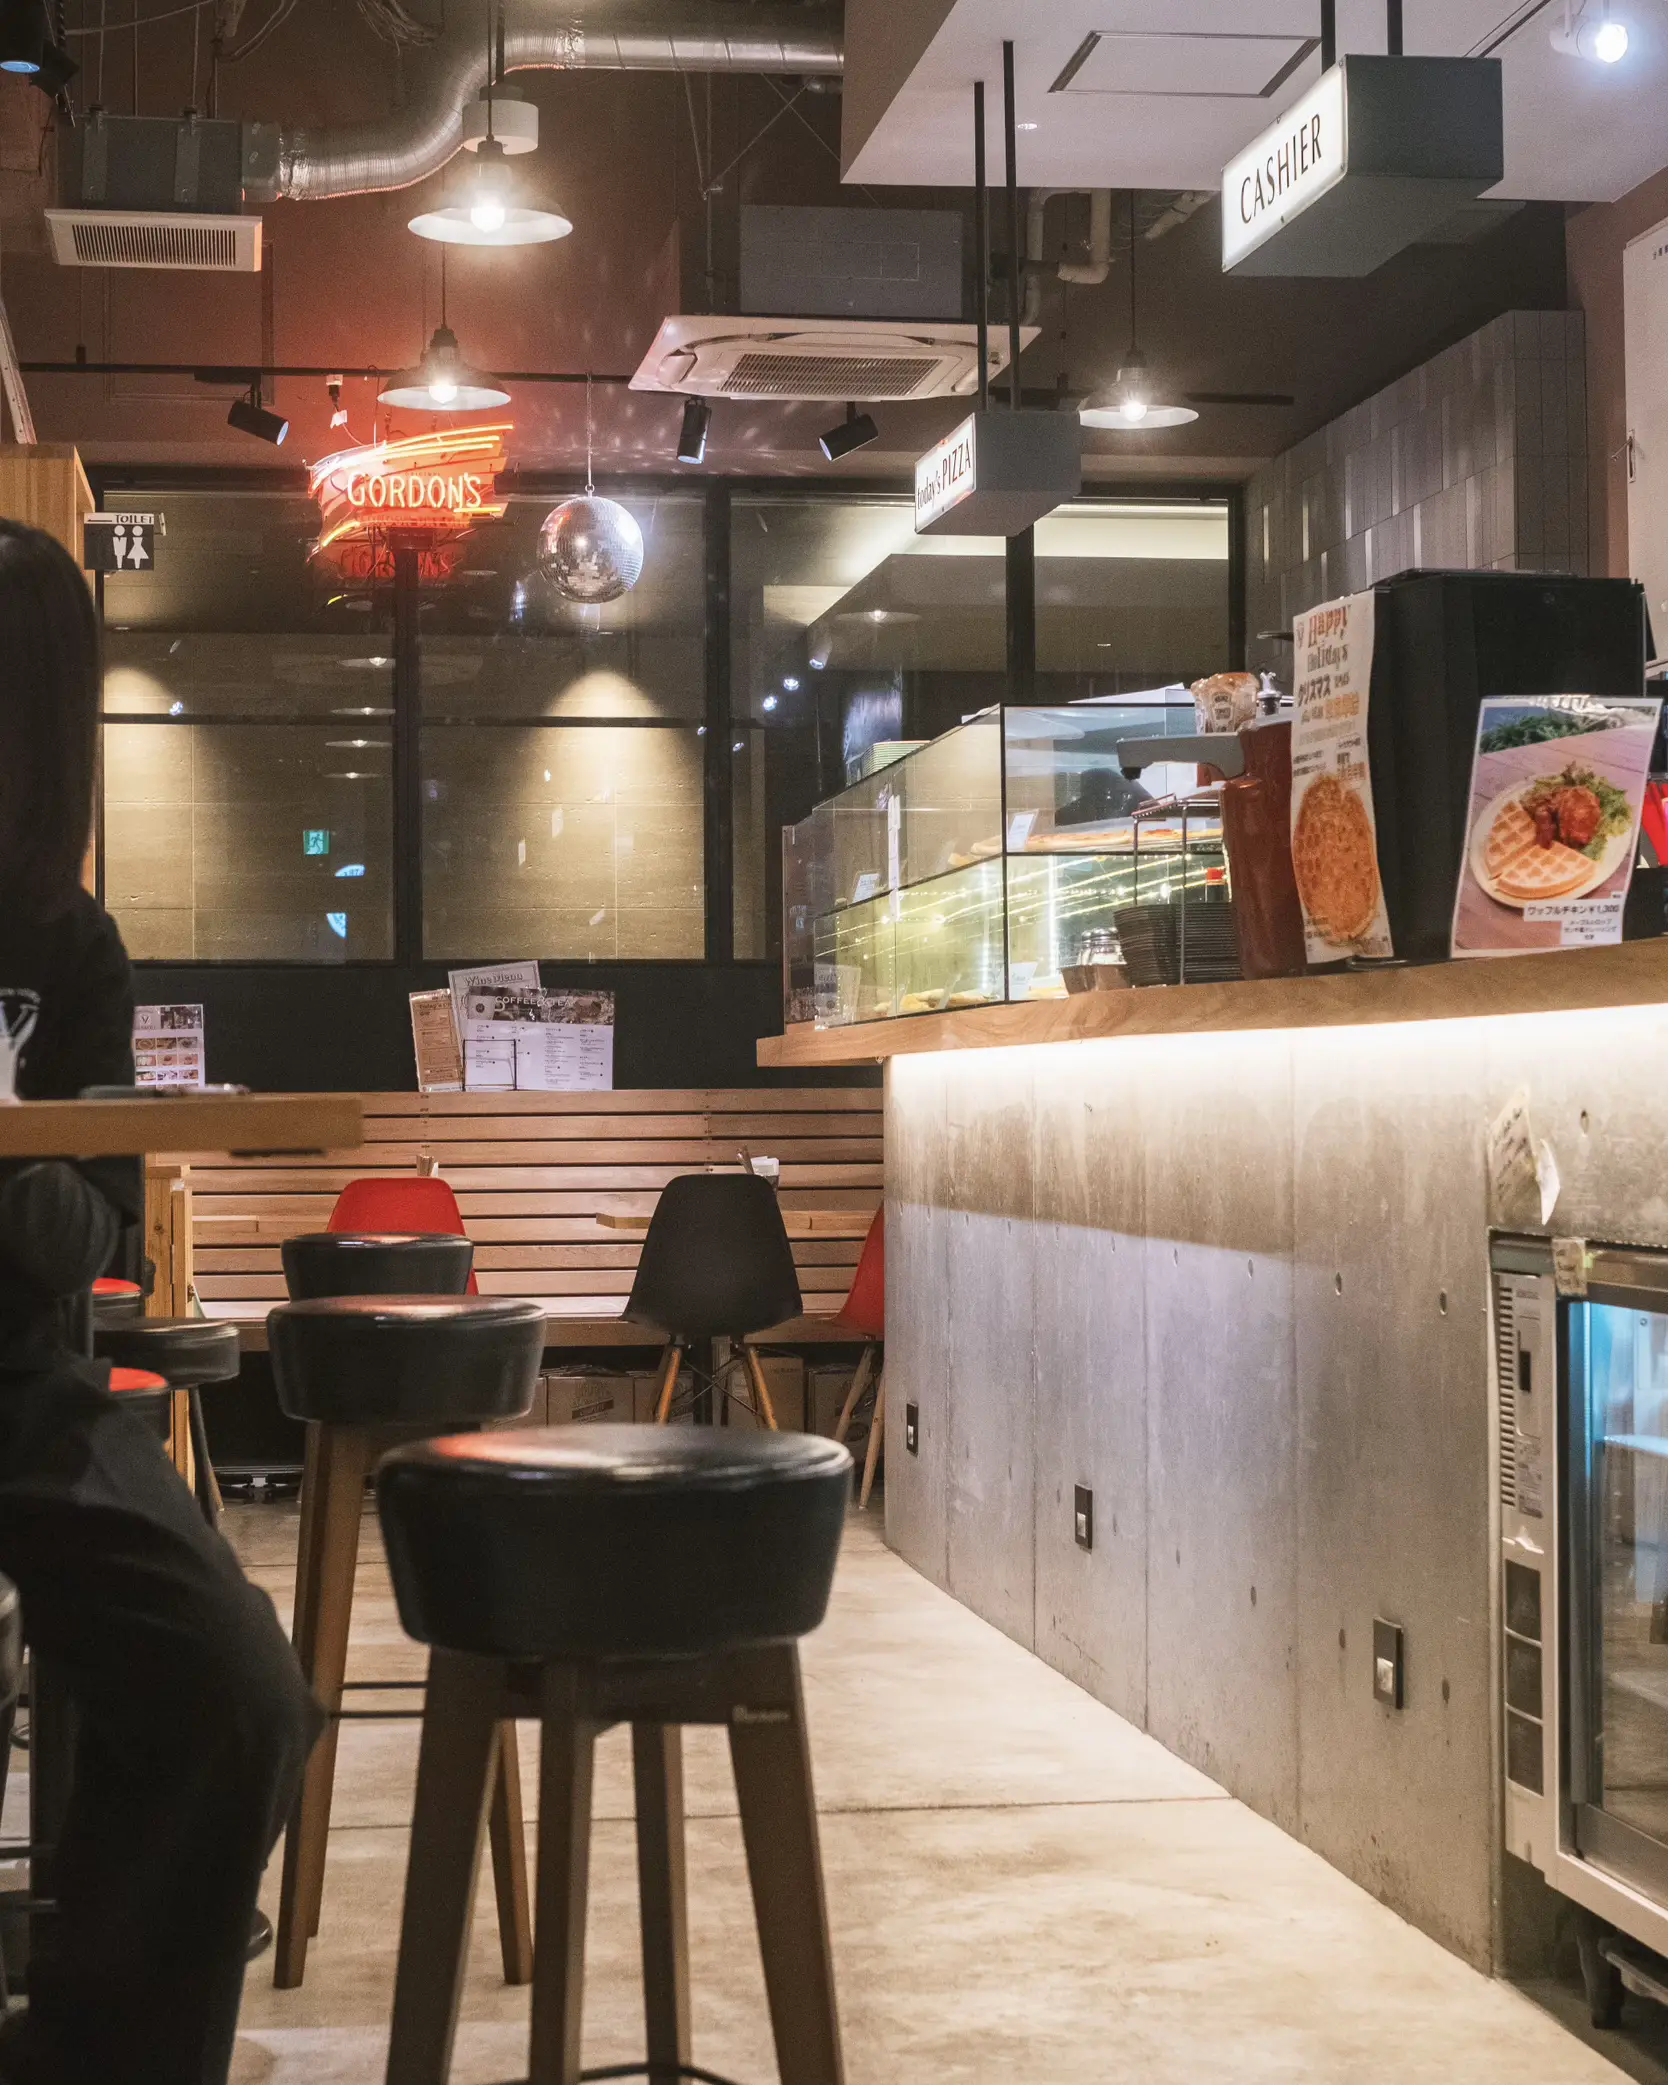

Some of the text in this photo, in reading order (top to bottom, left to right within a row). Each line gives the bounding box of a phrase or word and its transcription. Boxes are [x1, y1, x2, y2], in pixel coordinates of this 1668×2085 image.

[1240, 113, 1322, 225] CASHIER
[347, 472, 481, 511] GORDON'S
[917, 438, 971, 510] today's PIZZA
[115, 514, 153, 524] TOILET
